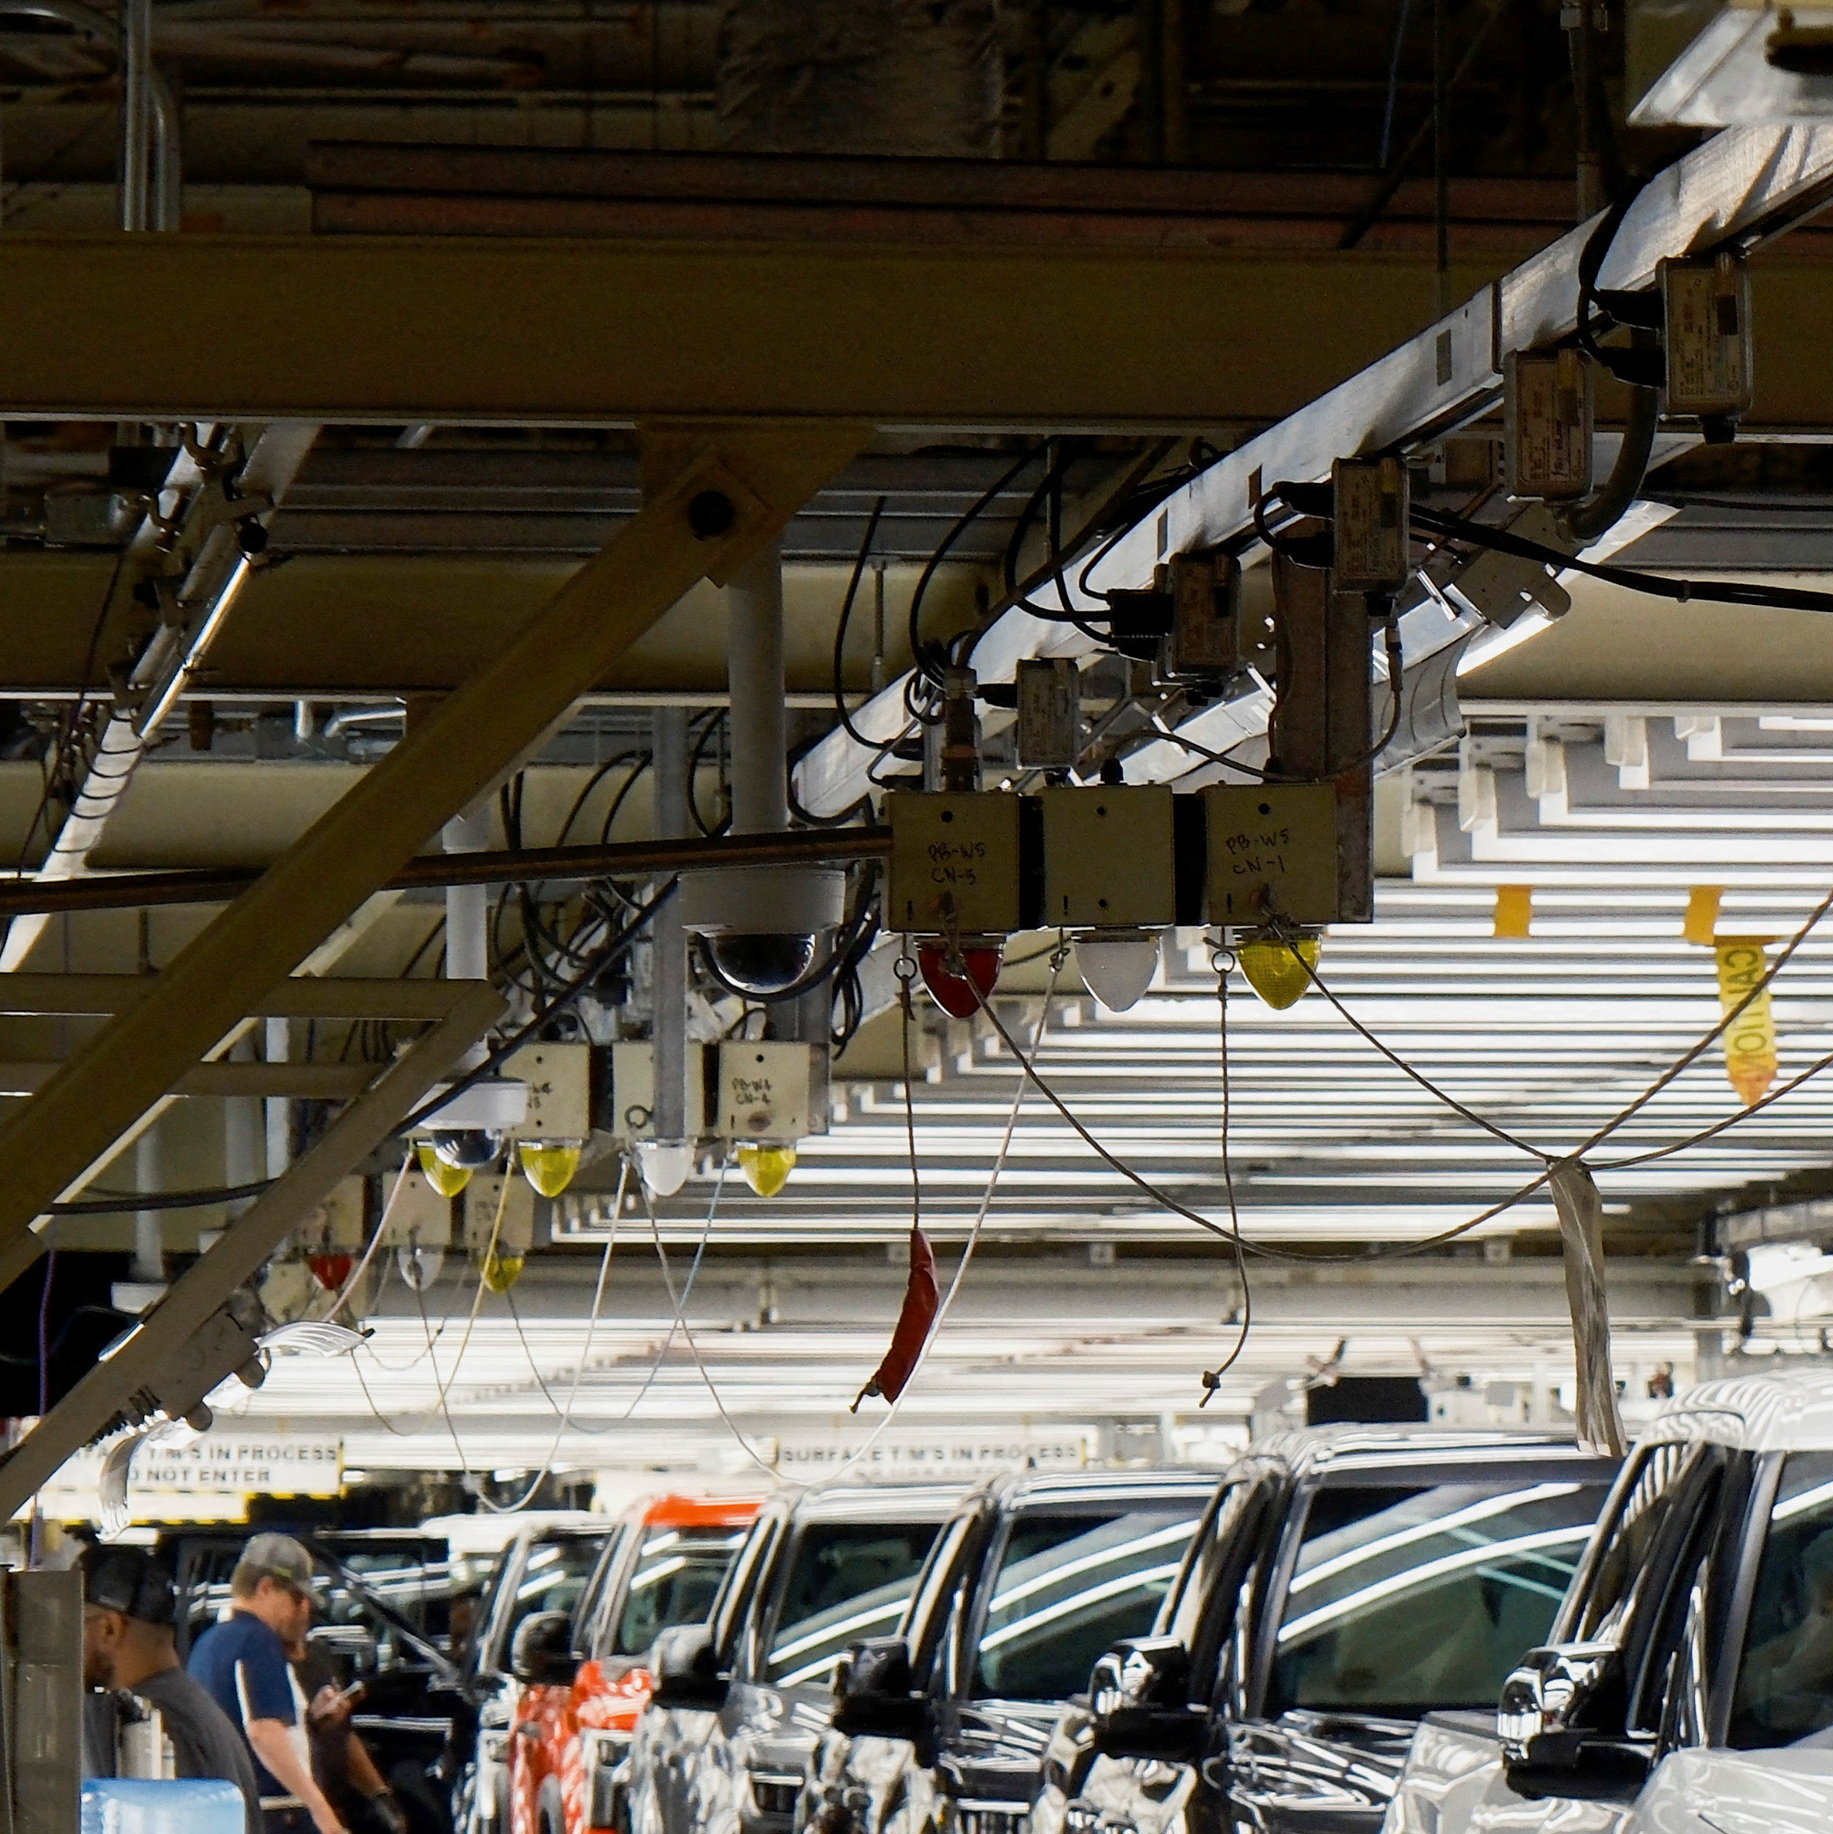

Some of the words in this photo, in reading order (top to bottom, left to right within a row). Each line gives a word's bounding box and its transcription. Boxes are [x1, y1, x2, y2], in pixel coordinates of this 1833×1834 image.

[1232, 855, 1286, 875] CN-1
[209, 1445, 231, 1460] IN
[238, 1445, 338, 1460] PROCESS
[146, 1467, 190, 1482] NOT
[199, 1467, 271, 1482] ENTER
